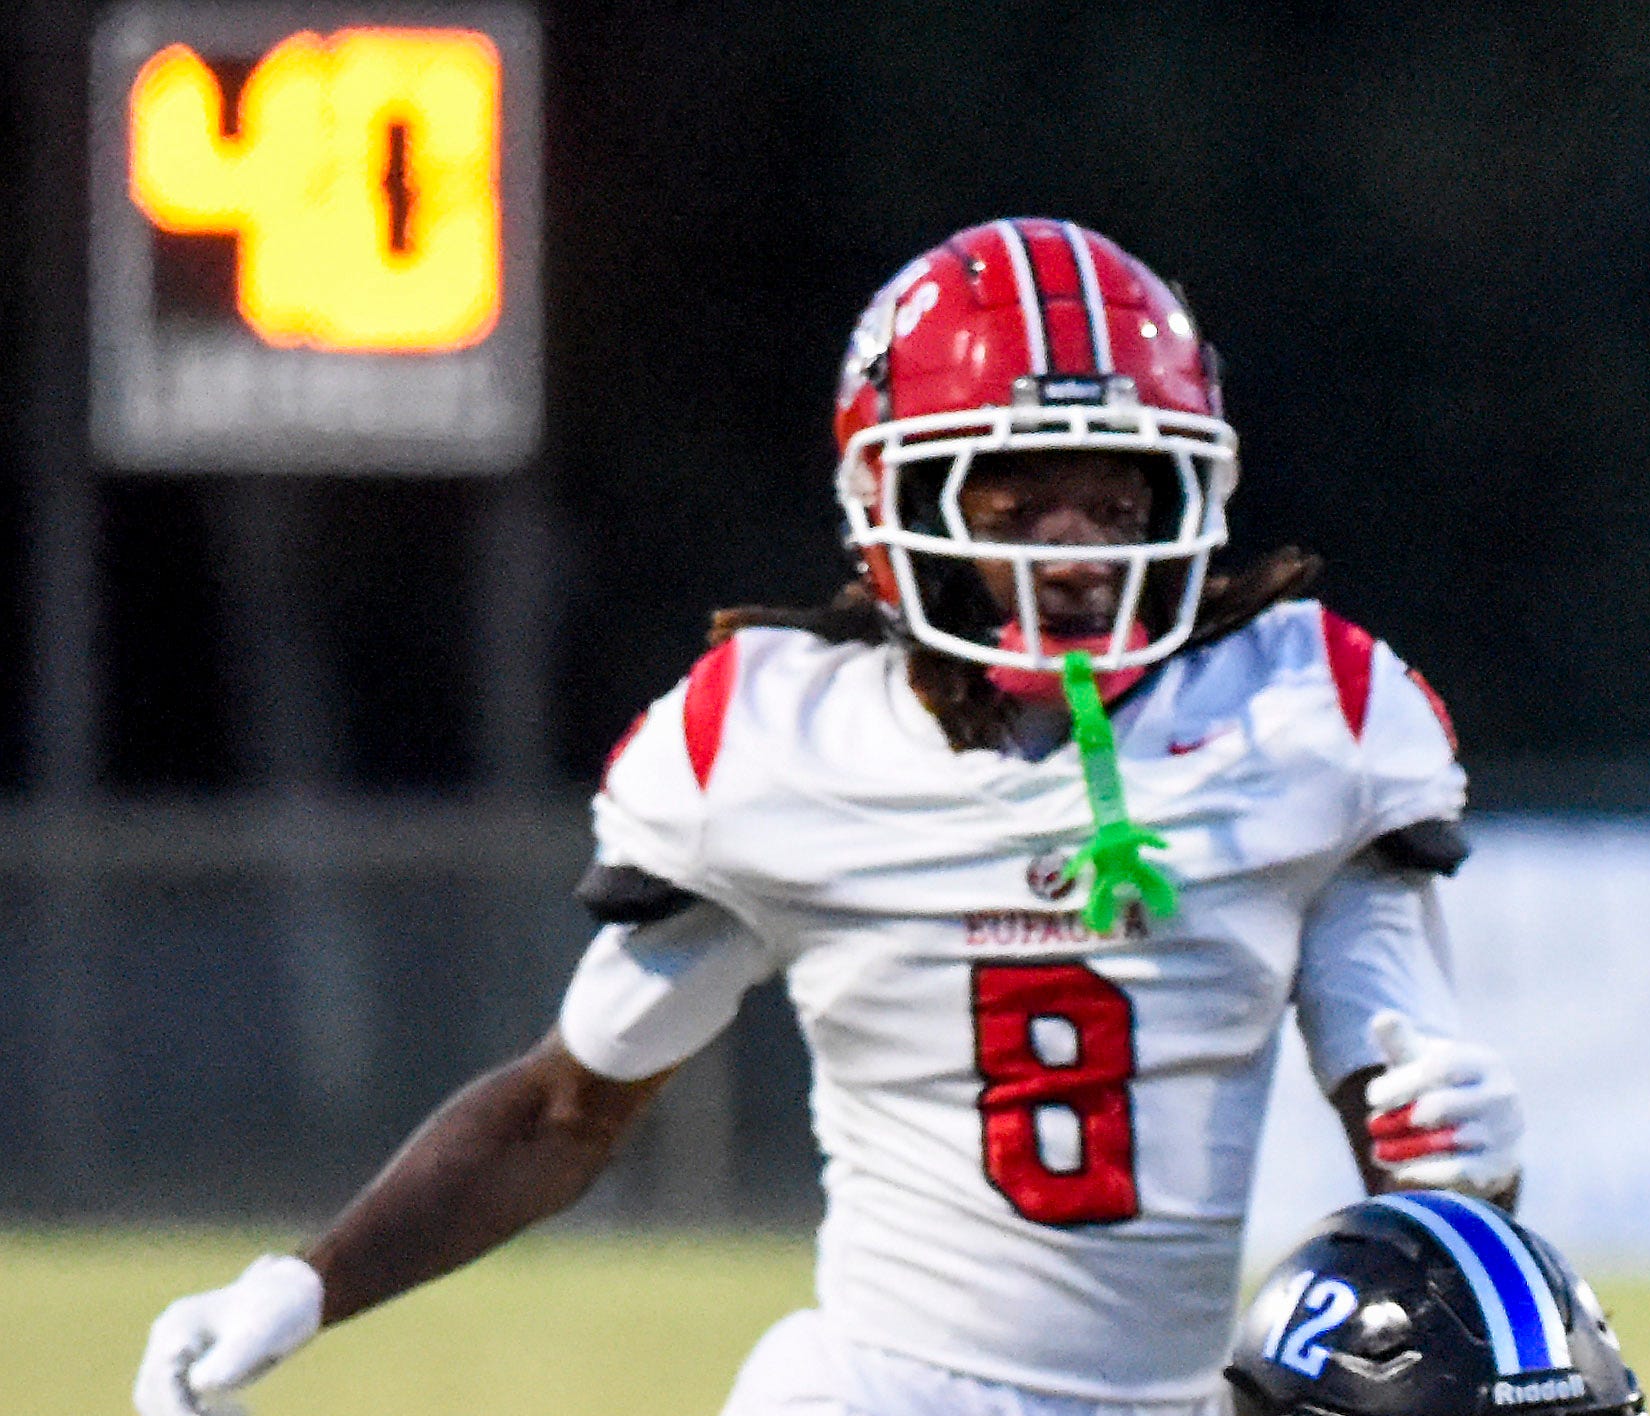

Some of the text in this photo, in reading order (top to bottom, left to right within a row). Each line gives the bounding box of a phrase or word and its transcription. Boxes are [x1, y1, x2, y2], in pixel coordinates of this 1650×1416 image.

[129, 26, 502, 354] 40
[971, 960, 1139, 1227] 8
[1263, 1269, 1359, 1380] 12
